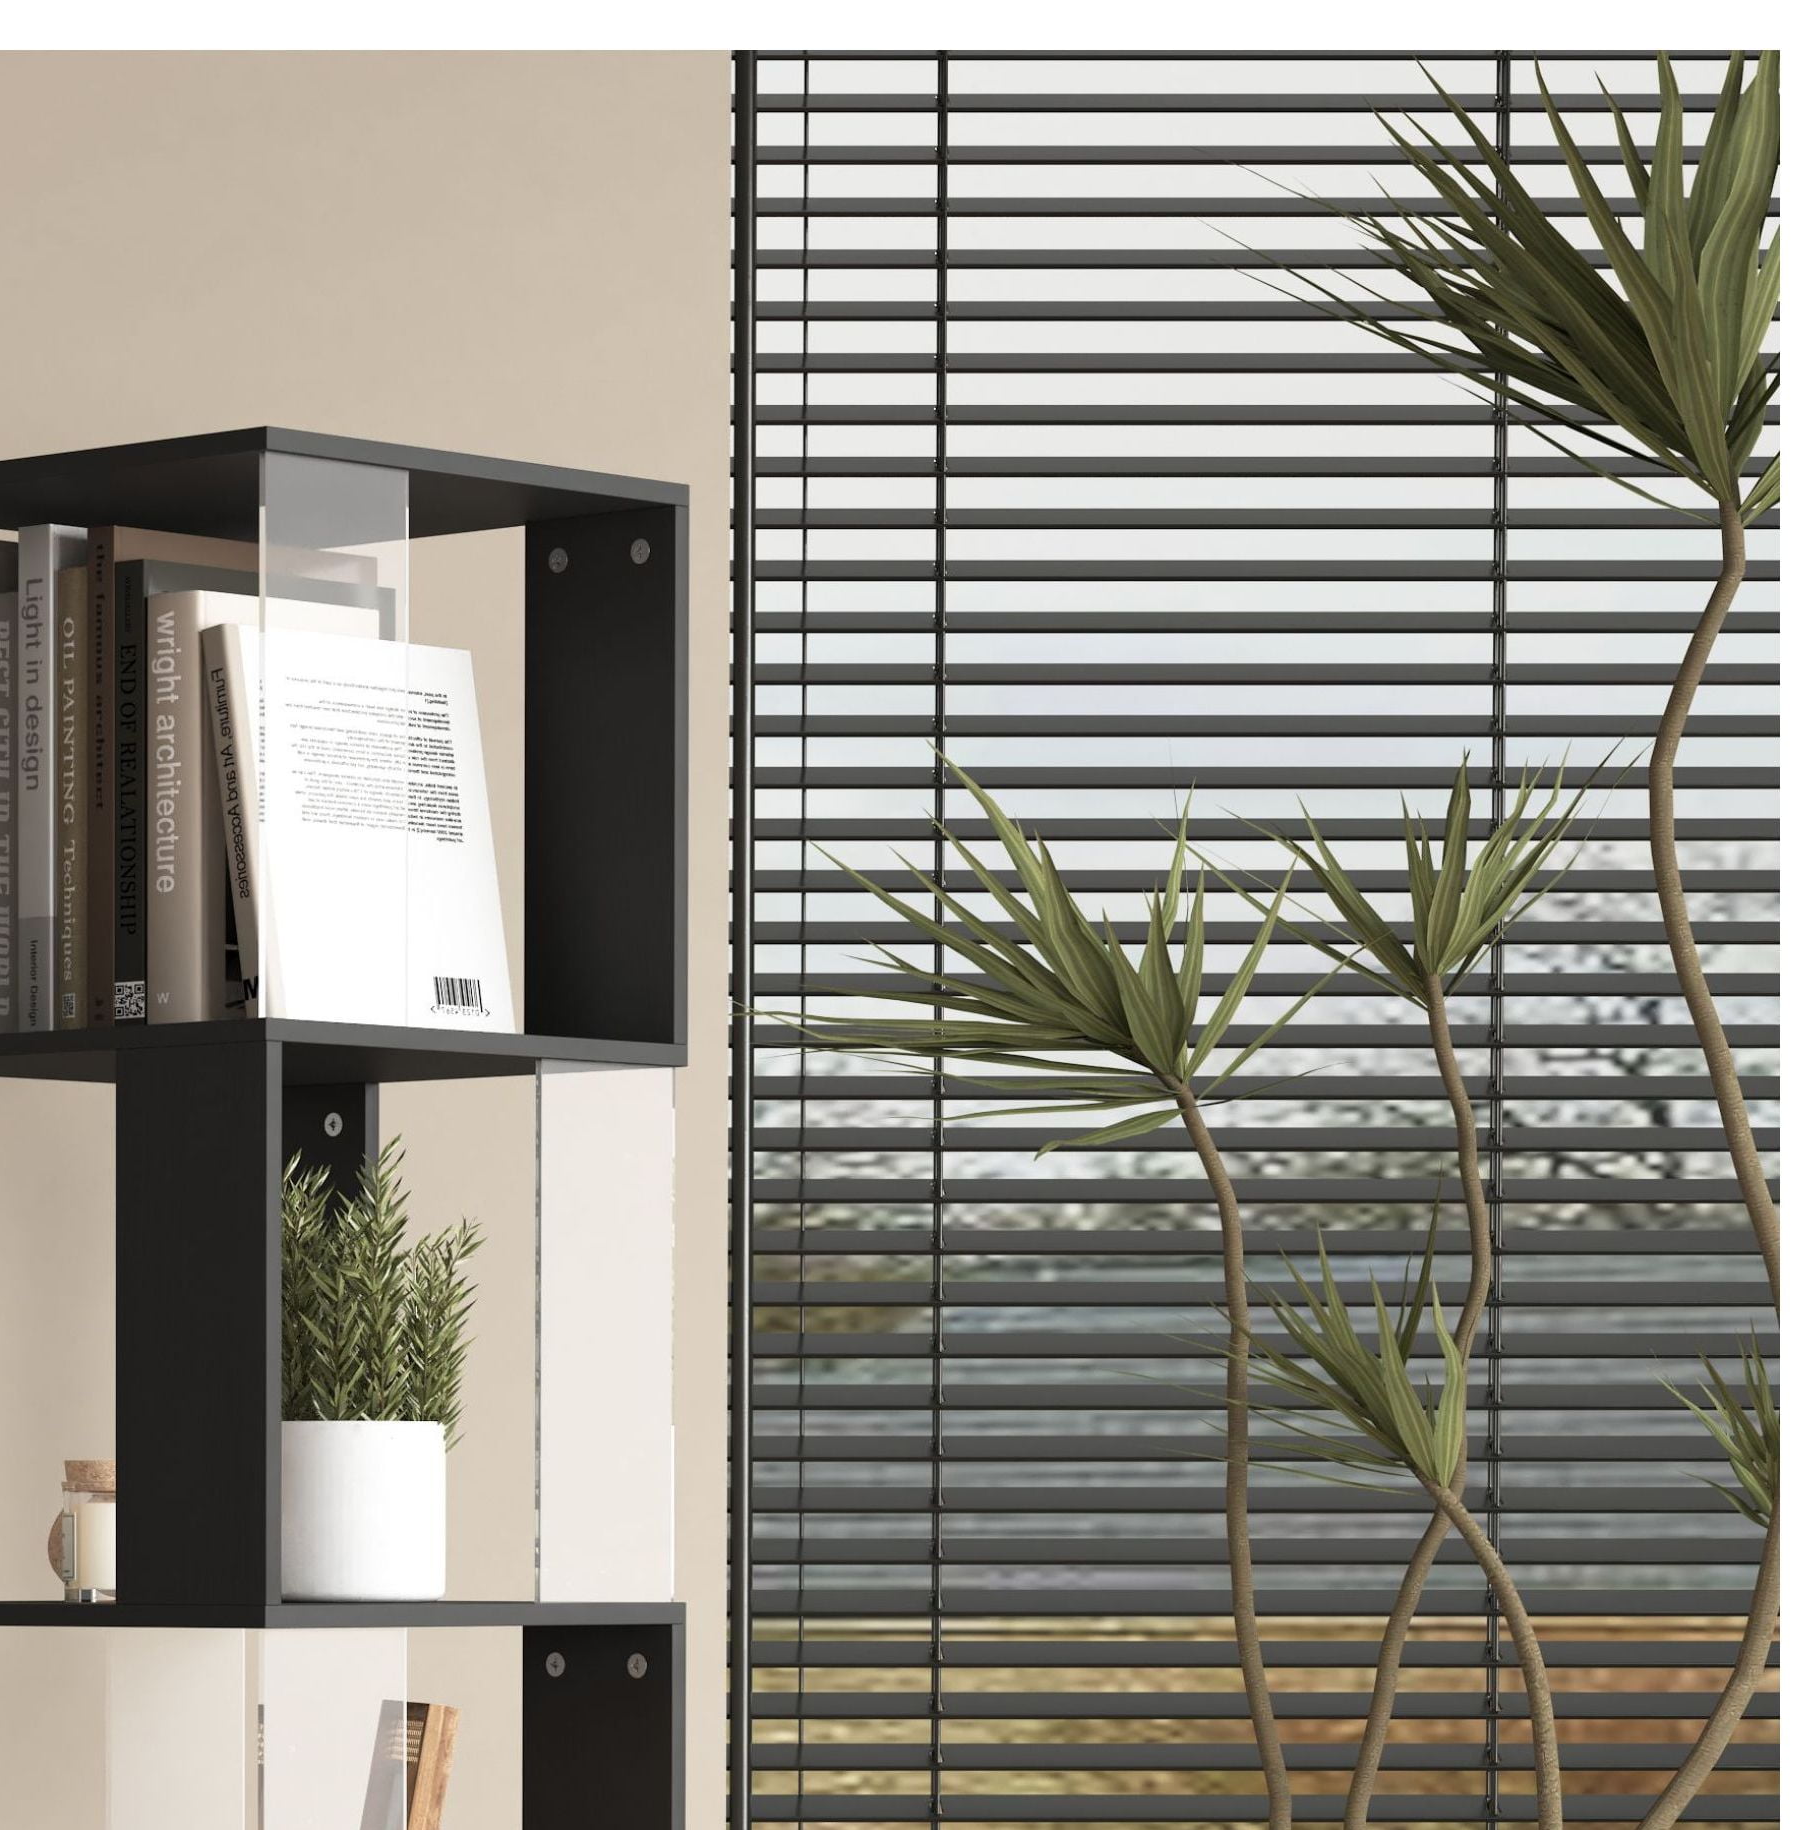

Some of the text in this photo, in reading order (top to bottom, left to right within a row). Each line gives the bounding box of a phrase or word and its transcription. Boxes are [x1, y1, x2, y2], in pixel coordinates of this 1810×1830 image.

[21, 578, 44, 791] Light in design
[94, 544, 105, 811] the famous architect
[120, 643, 137, 694] END
[120, 701, 137, 733] OF
[151, 611, 182, 893] wright architecture
[60, 617, 76, 981] OIL PAINTING Techniques
[120, 742, 137, 935] REALATIONSHIP
[28, 940, 38, 1027] Interior Design
